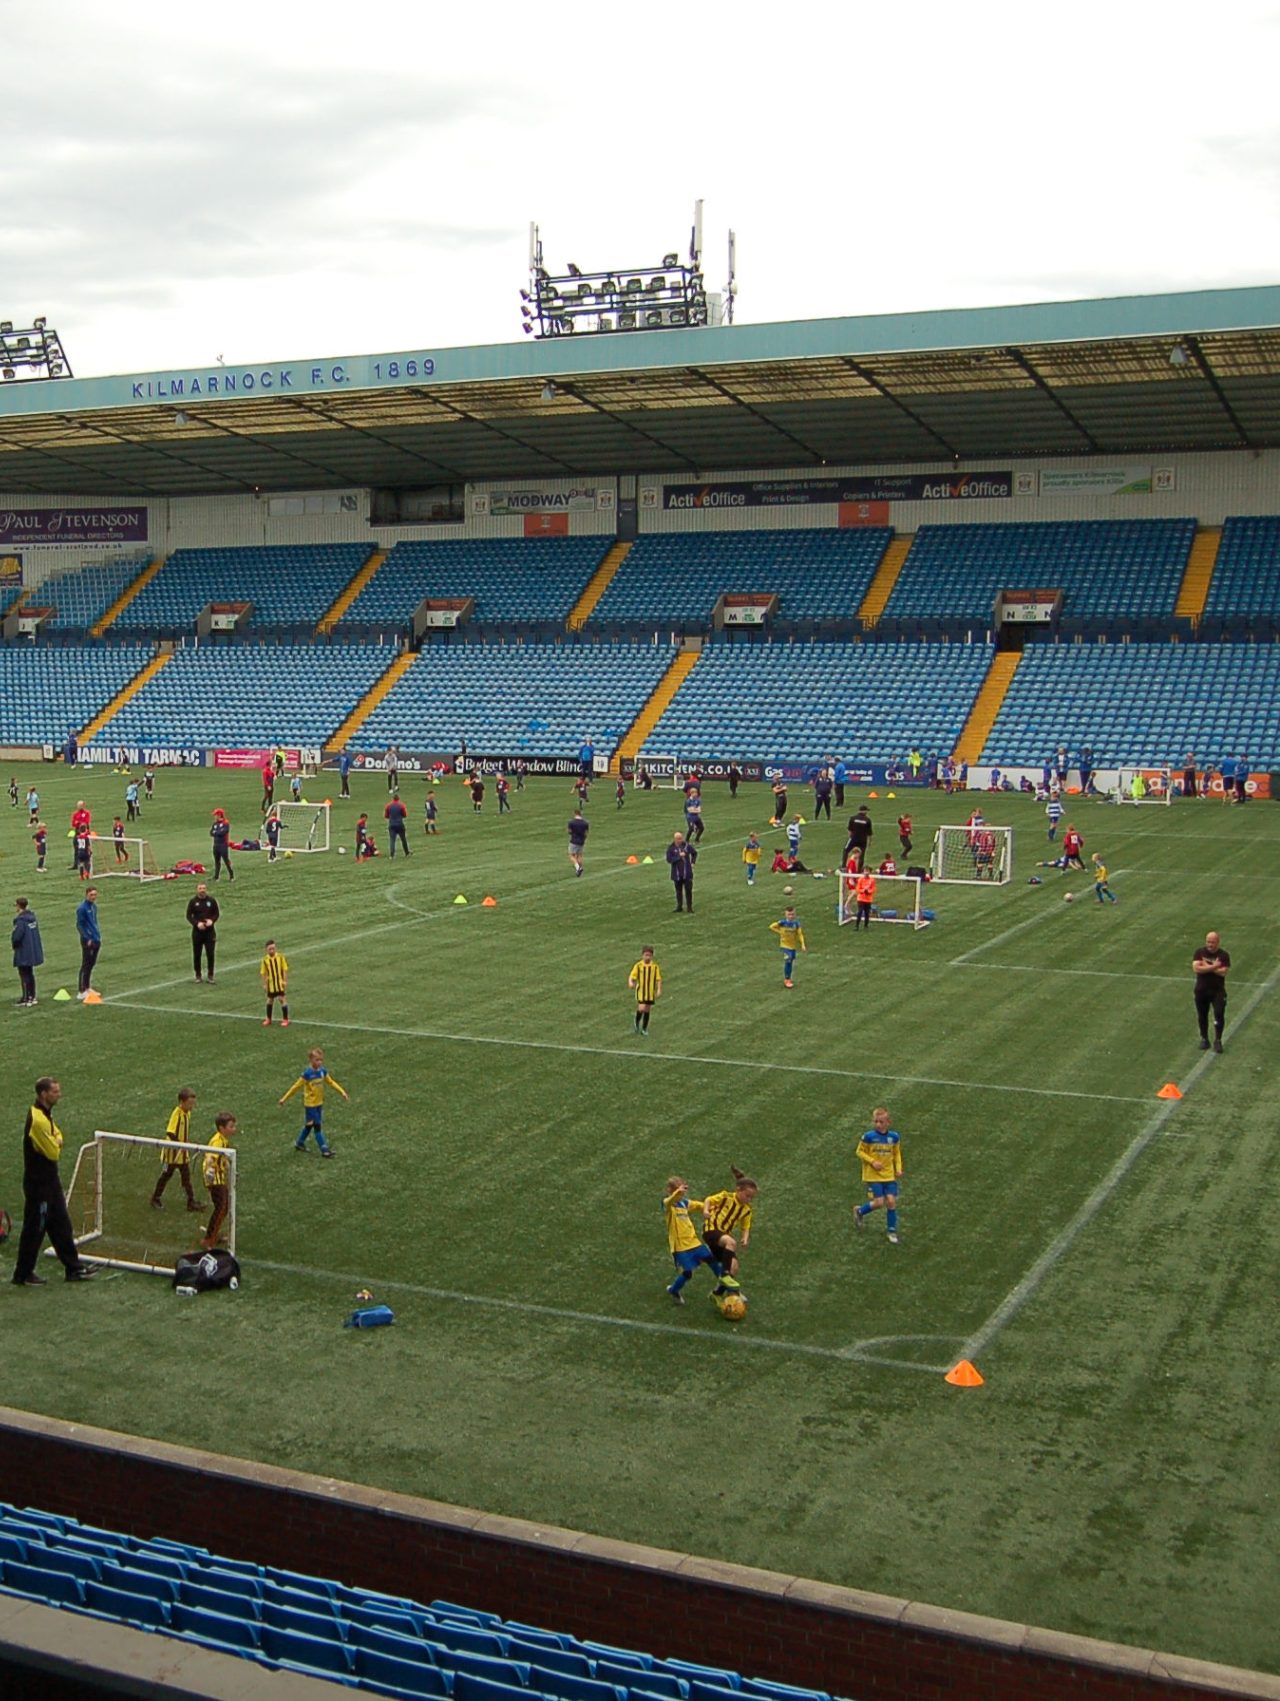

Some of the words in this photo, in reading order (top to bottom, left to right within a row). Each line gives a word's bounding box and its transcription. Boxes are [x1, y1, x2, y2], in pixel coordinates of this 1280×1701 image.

[132, 370, 292, 398] KILMARNOCK
[311, 365, 350, 385] F.C.
[374, 358, 436, 380] 1869
[507, 494, 572, 507] MODWAY
[365, 757, 421, 769] Dono's
[465, 758, 504, 772] Budget
[507, 758, 555, 772] Wndow
